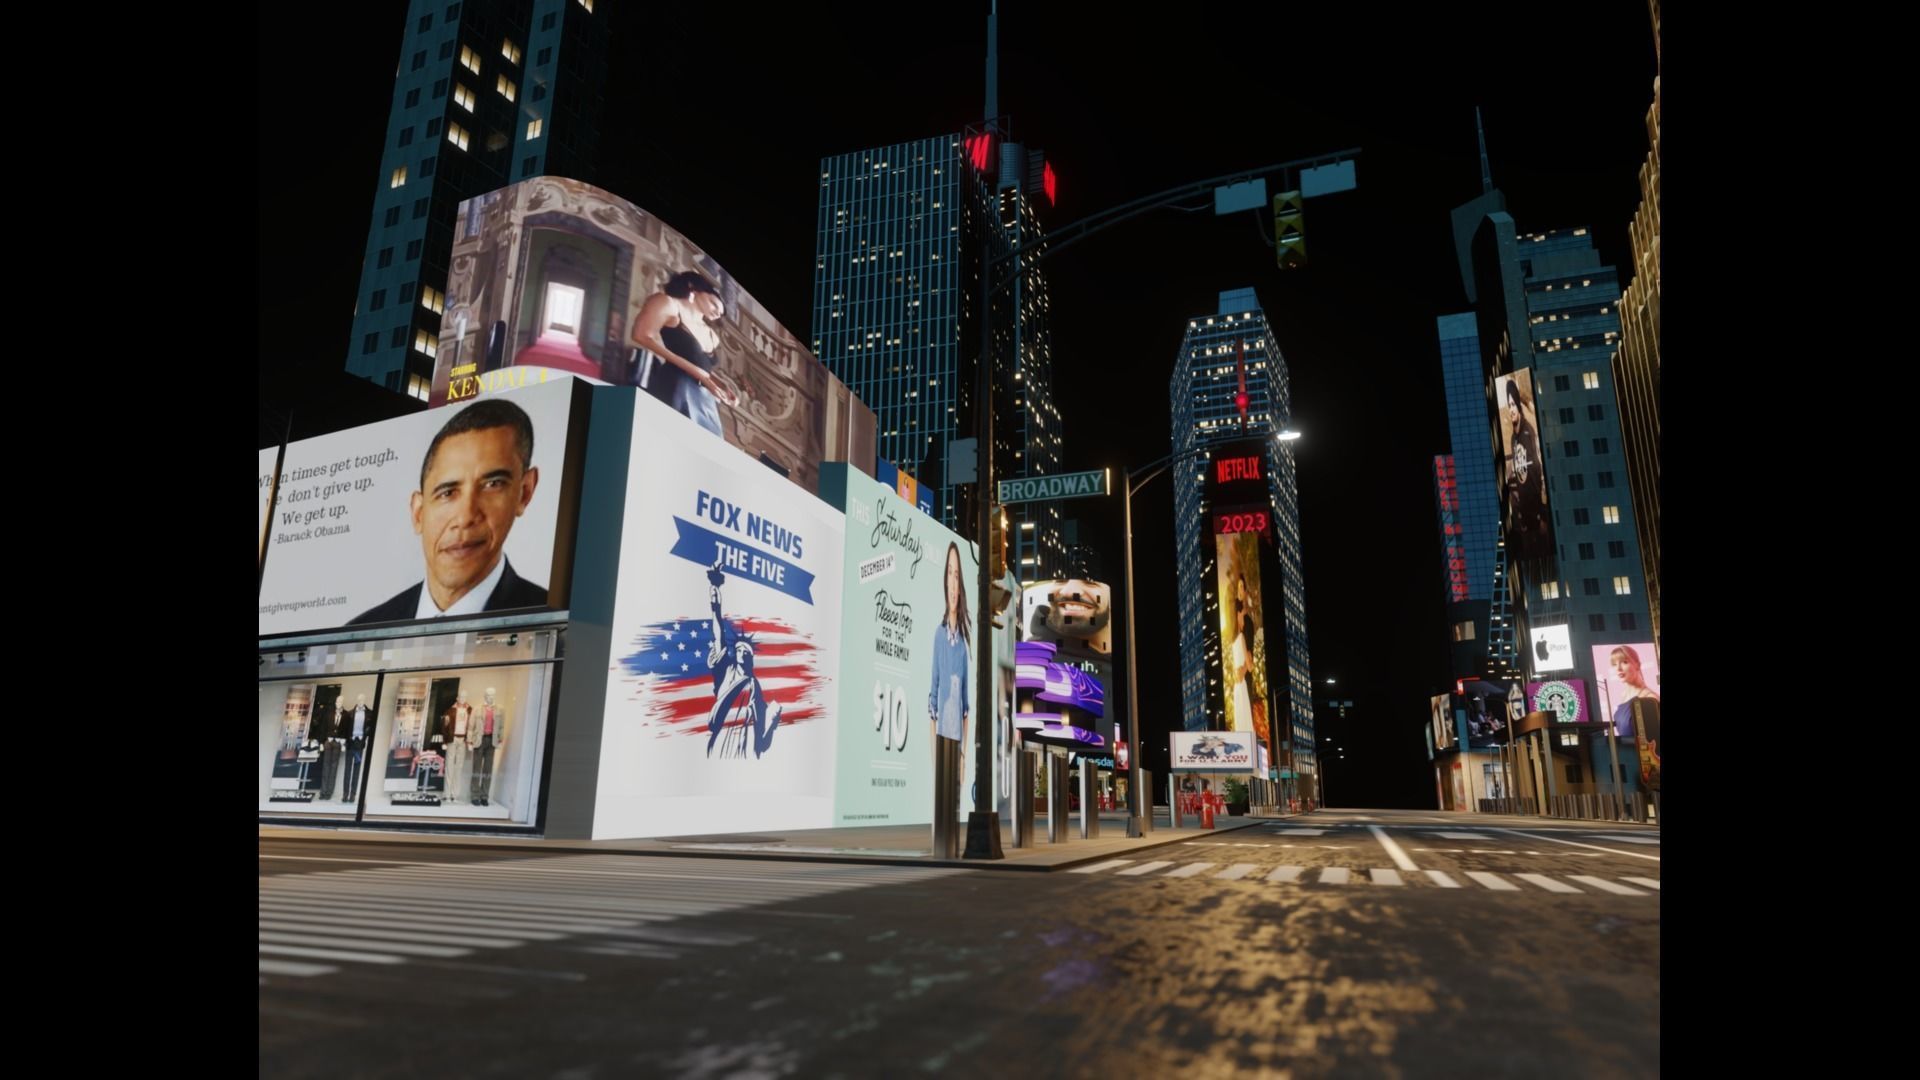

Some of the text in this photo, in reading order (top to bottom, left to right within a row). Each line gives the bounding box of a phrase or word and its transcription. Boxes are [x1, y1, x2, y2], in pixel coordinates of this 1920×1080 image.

[291, 464, 327, 481] times
[329, 458, 352, 477] get
[1217, 456, 1260, 484] NETFLIX
[287, 484, 320, 503] don't
[322, 481, 351, 500] give
[354, 477, 375, 492] up.
[1000, 473, 1103, 501] BROADWAY
[282, 504, 349, 526] We get up.
[696, 489, 803, 560] FOX NEWS
[852, 497, 871, 526] THIS
[1221, 513, 1267, 533] 2023
[314, 524, 350, 538] Obama
[871, 496, 924, 580] Saturday
[715, 540, 785, 586] THE FIVE
[860, 558, 885, 579] DECEMBER
[875, 588, 899, 626] Fleece
[882, 626, 905, 643] FOR THE
[875, 637, 910, 661] WHOLE FAMILY
[873, 679, 909, 753] $10
